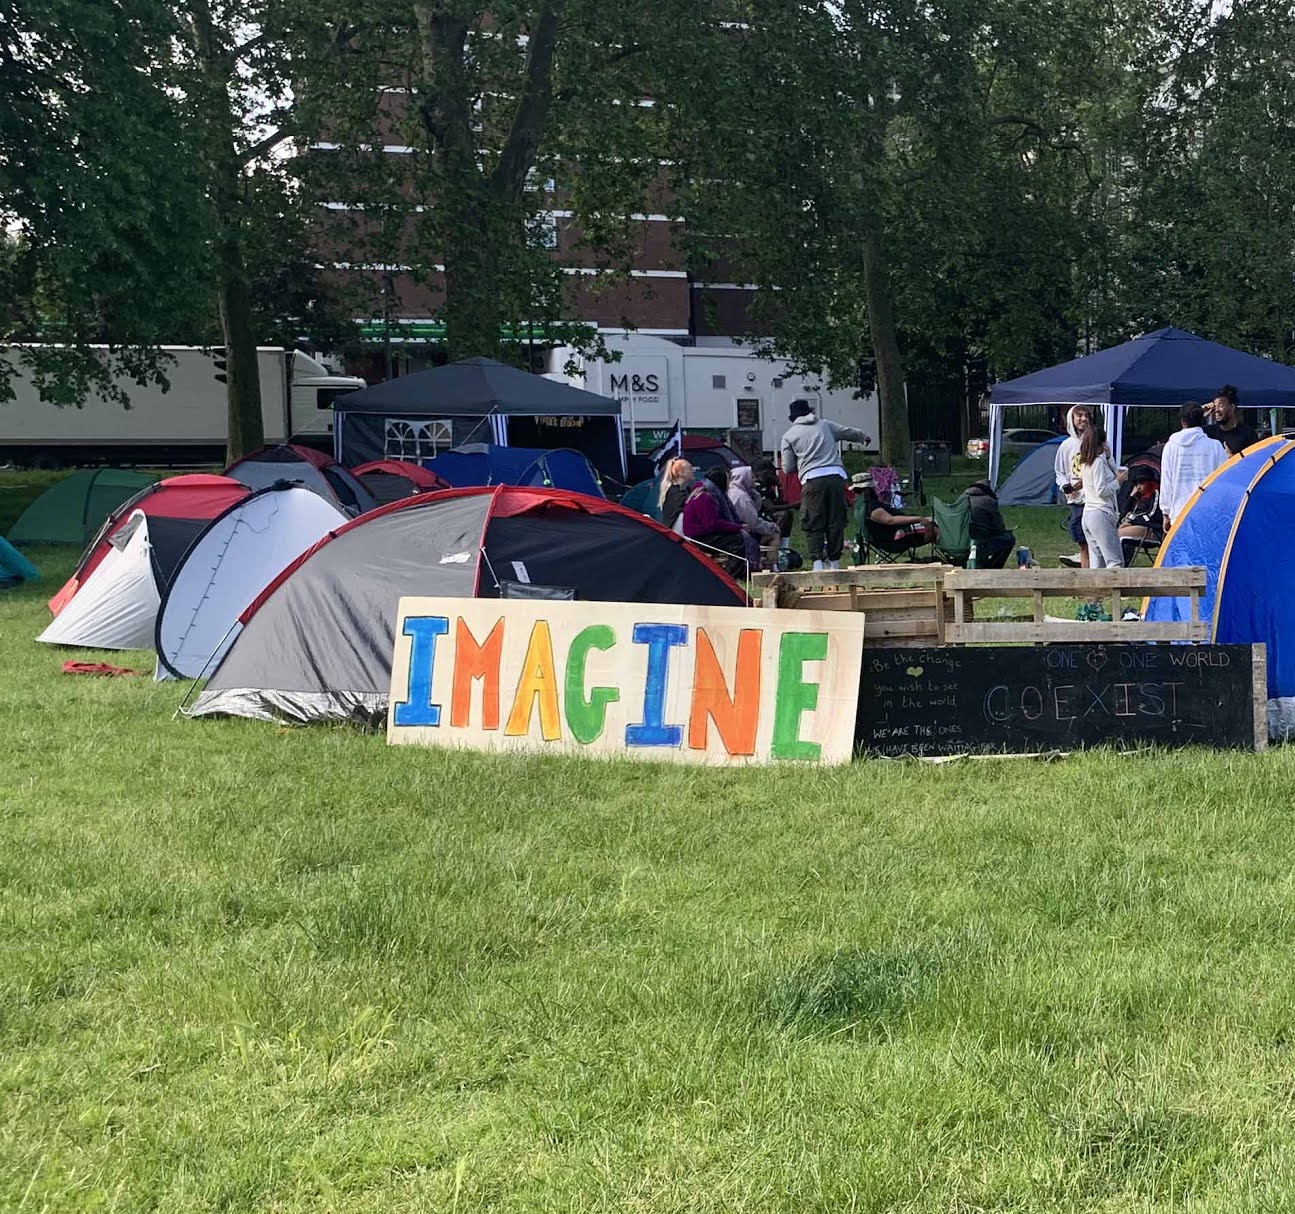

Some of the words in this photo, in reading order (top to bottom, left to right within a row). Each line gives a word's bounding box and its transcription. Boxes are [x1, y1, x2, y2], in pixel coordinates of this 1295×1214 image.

[610, 374, 659, 392] M&S
[872, 658, 890, 672] Be
[894, 653, 914, 665] the
[1046, 650, 1079, 669] ONE
[1119, 651, 1161, 668] ONE
[1169, 651, 1231, 668] WORLD
[394, 615, 829, 761] IMAGINE
[874, 684, 894, 697] you
[899, 680, 923, 692] wish
[928, 679, 940, 691] to
[942, 682, 959, 691] see
[902, 695, 923, 709] the
[929, 695, 957, 707] world
[984, 682, 1185, 723] COEXIST
[873, 728, 887, 739] WE
[892, 726, 910, 737] ARE
[914, 724, 933, 737] THE
[938, 724, 962, 735] ONES
